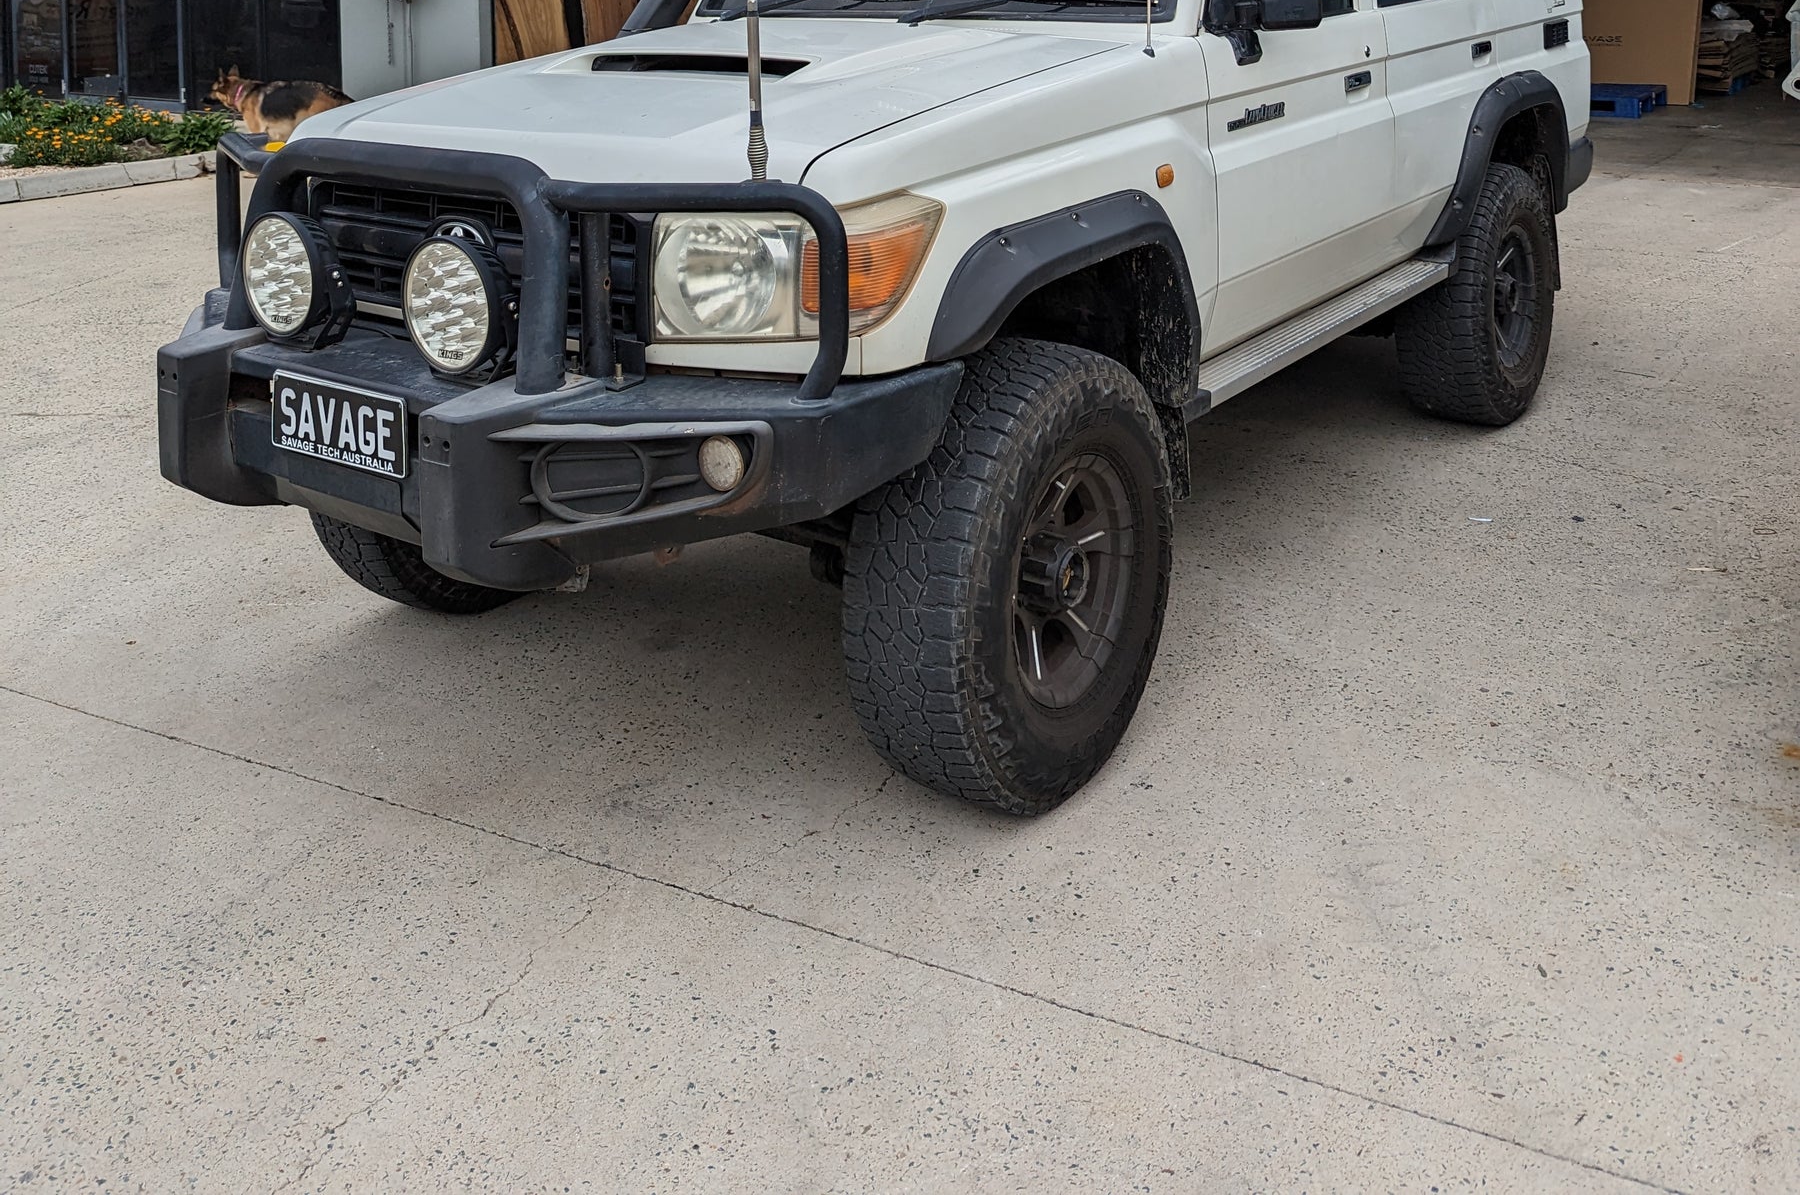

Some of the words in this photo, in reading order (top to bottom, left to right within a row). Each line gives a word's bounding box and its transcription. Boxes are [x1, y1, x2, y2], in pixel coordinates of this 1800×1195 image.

[271, 315, 292, 324] KINGS
[438, 349, 464, 360] KINGS
[280, 387, 396, 461] SAVAGE
[281, 436, 315, 453] SAVAGE
[316, 444, 340, 459] TECH
[342, 451, 394, 473] AUSTRALIA
